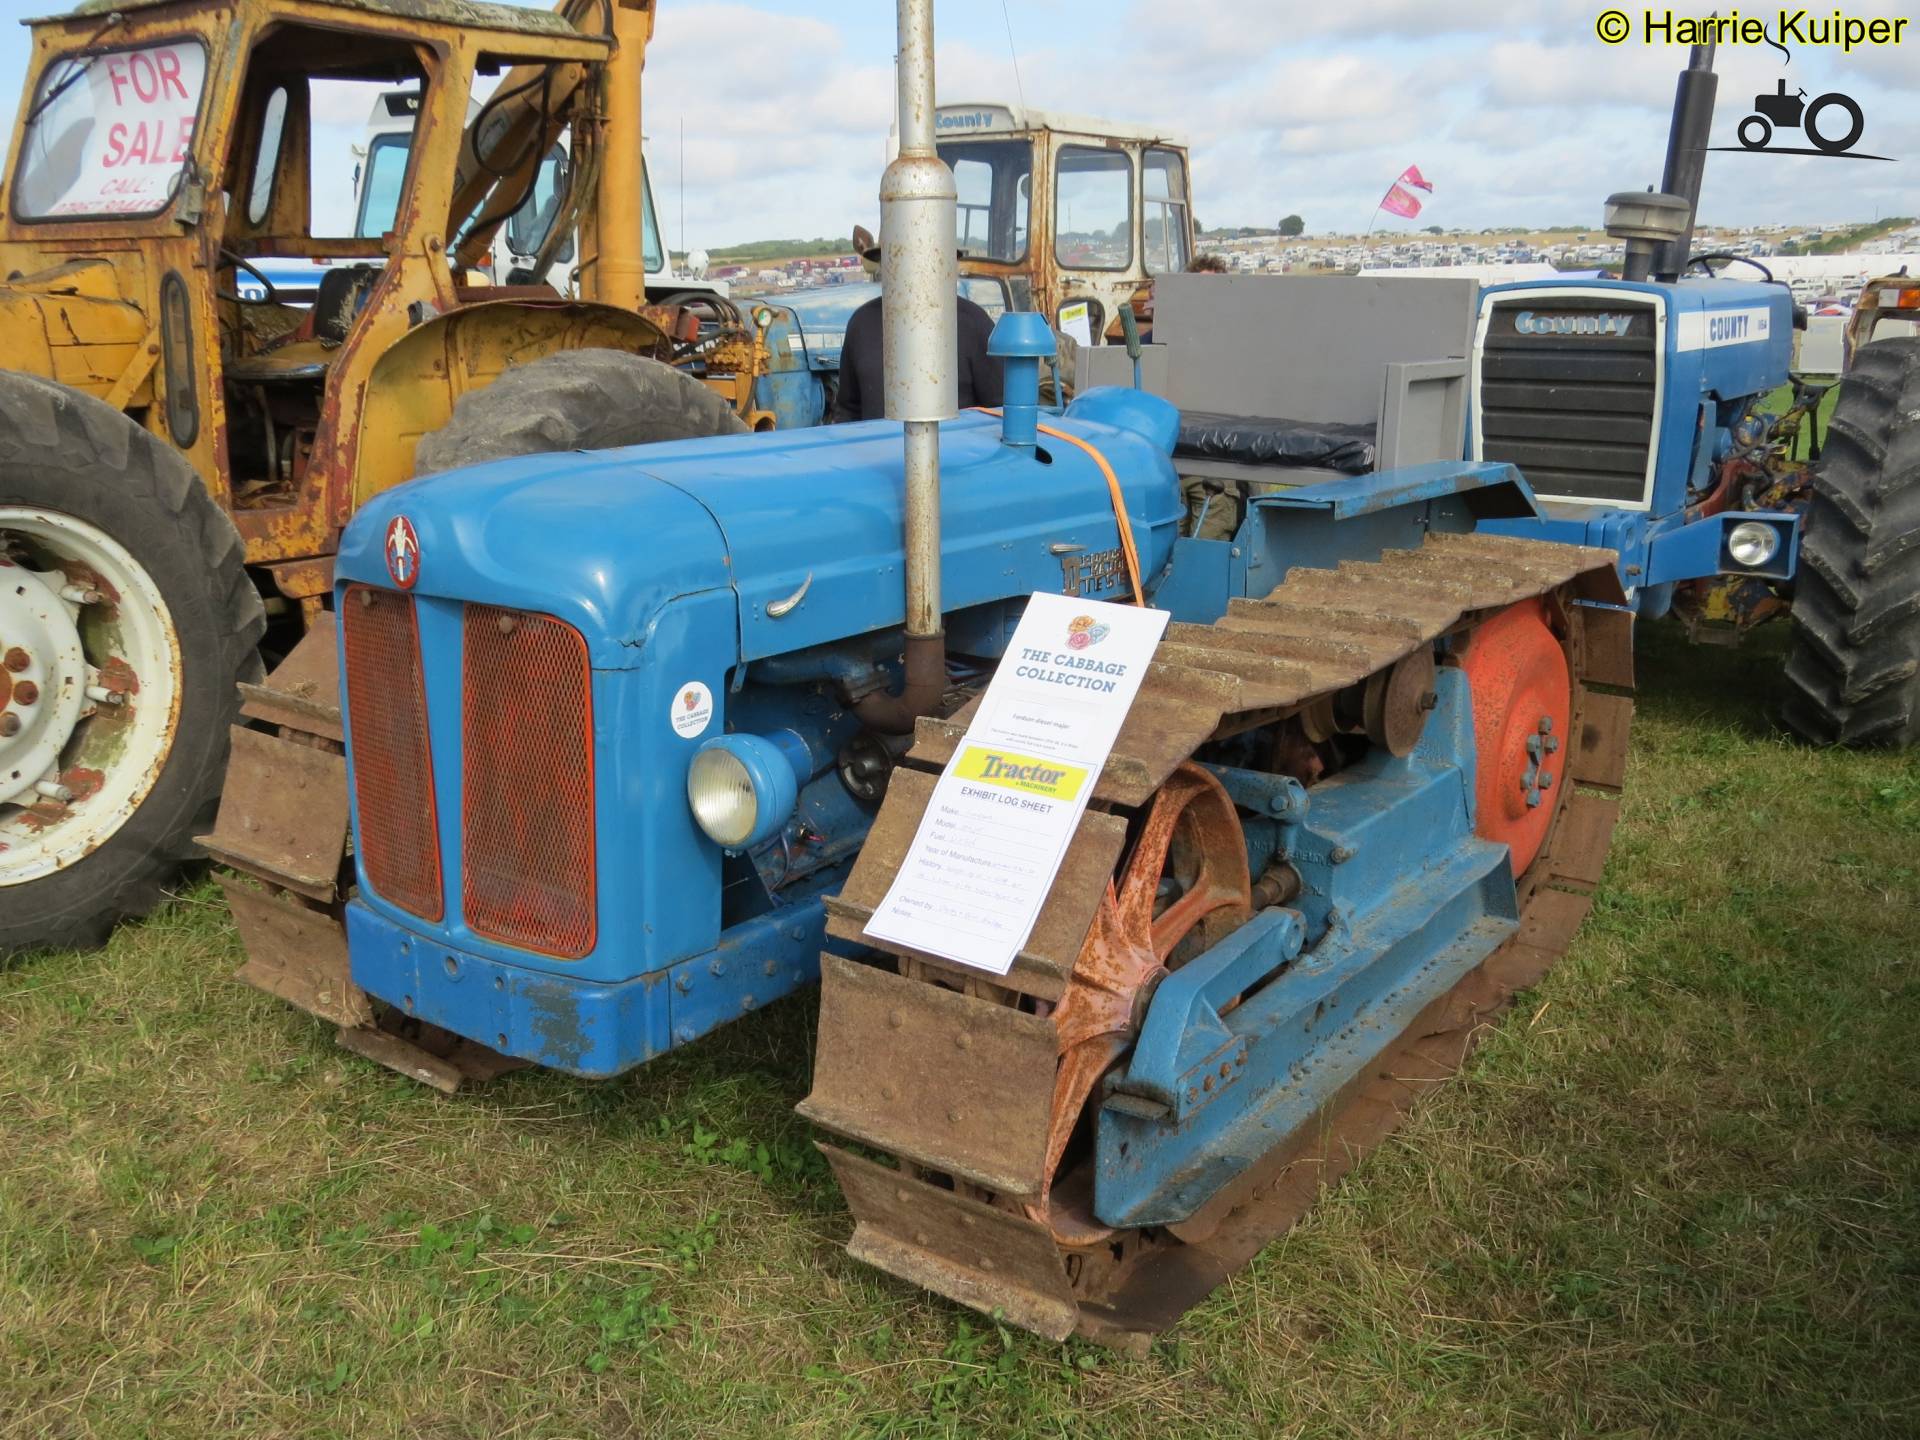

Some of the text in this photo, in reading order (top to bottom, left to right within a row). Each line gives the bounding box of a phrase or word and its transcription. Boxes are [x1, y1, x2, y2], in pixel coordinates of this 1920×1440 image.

[104, 49, 189, 106] FOR
[102, 116, 196, 168] SALE
[1515, 311, 1633, 336] County
[1710, 315, 1749, 342] COUNTY
[1022, 648, 1127, 677] THE CABBAGE
[1016, 666, 1117, 693] COLLECTION
[979, 754, 1066, 785] Tractor
[960, 786, 1053, 814] EXHIBIT LOG SHEET
